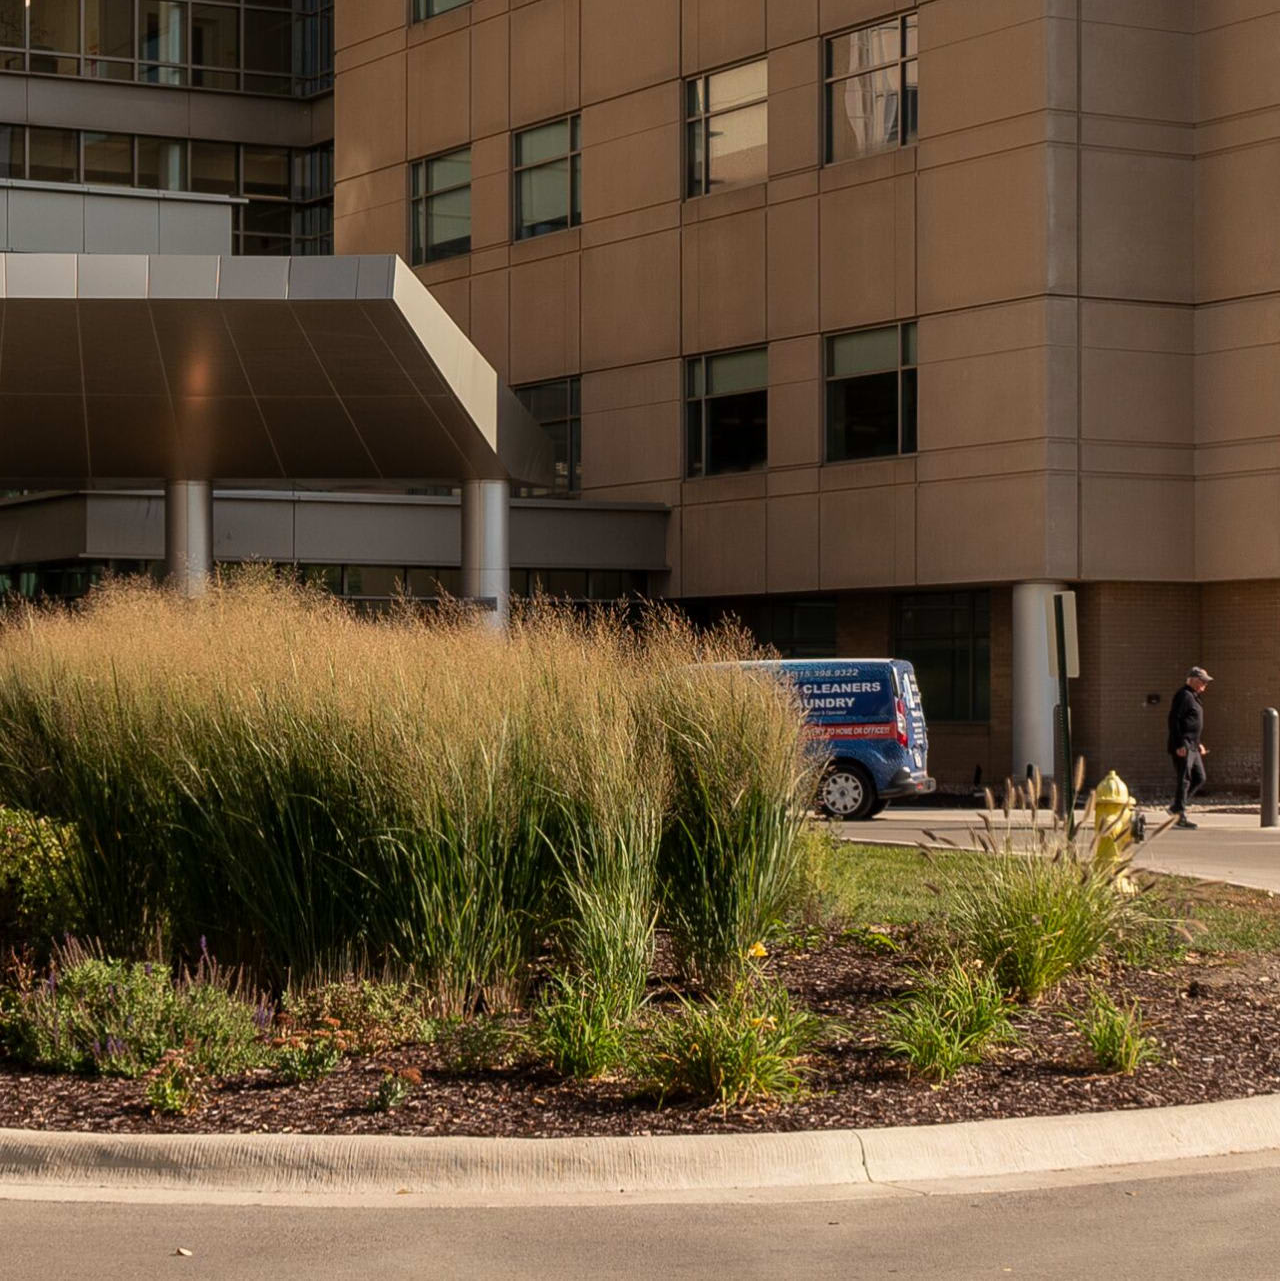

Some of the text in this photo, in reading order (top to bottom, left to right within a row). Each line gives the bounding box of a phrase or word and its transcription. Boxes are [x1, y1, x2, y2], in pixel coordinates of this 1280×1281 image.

[803, 682, 881, 694] CLEANERS
[794, 697, 856, 708] AUNDRY
[835, 727, 853, 735] HOME
[853, 727, 862, 735] OR
